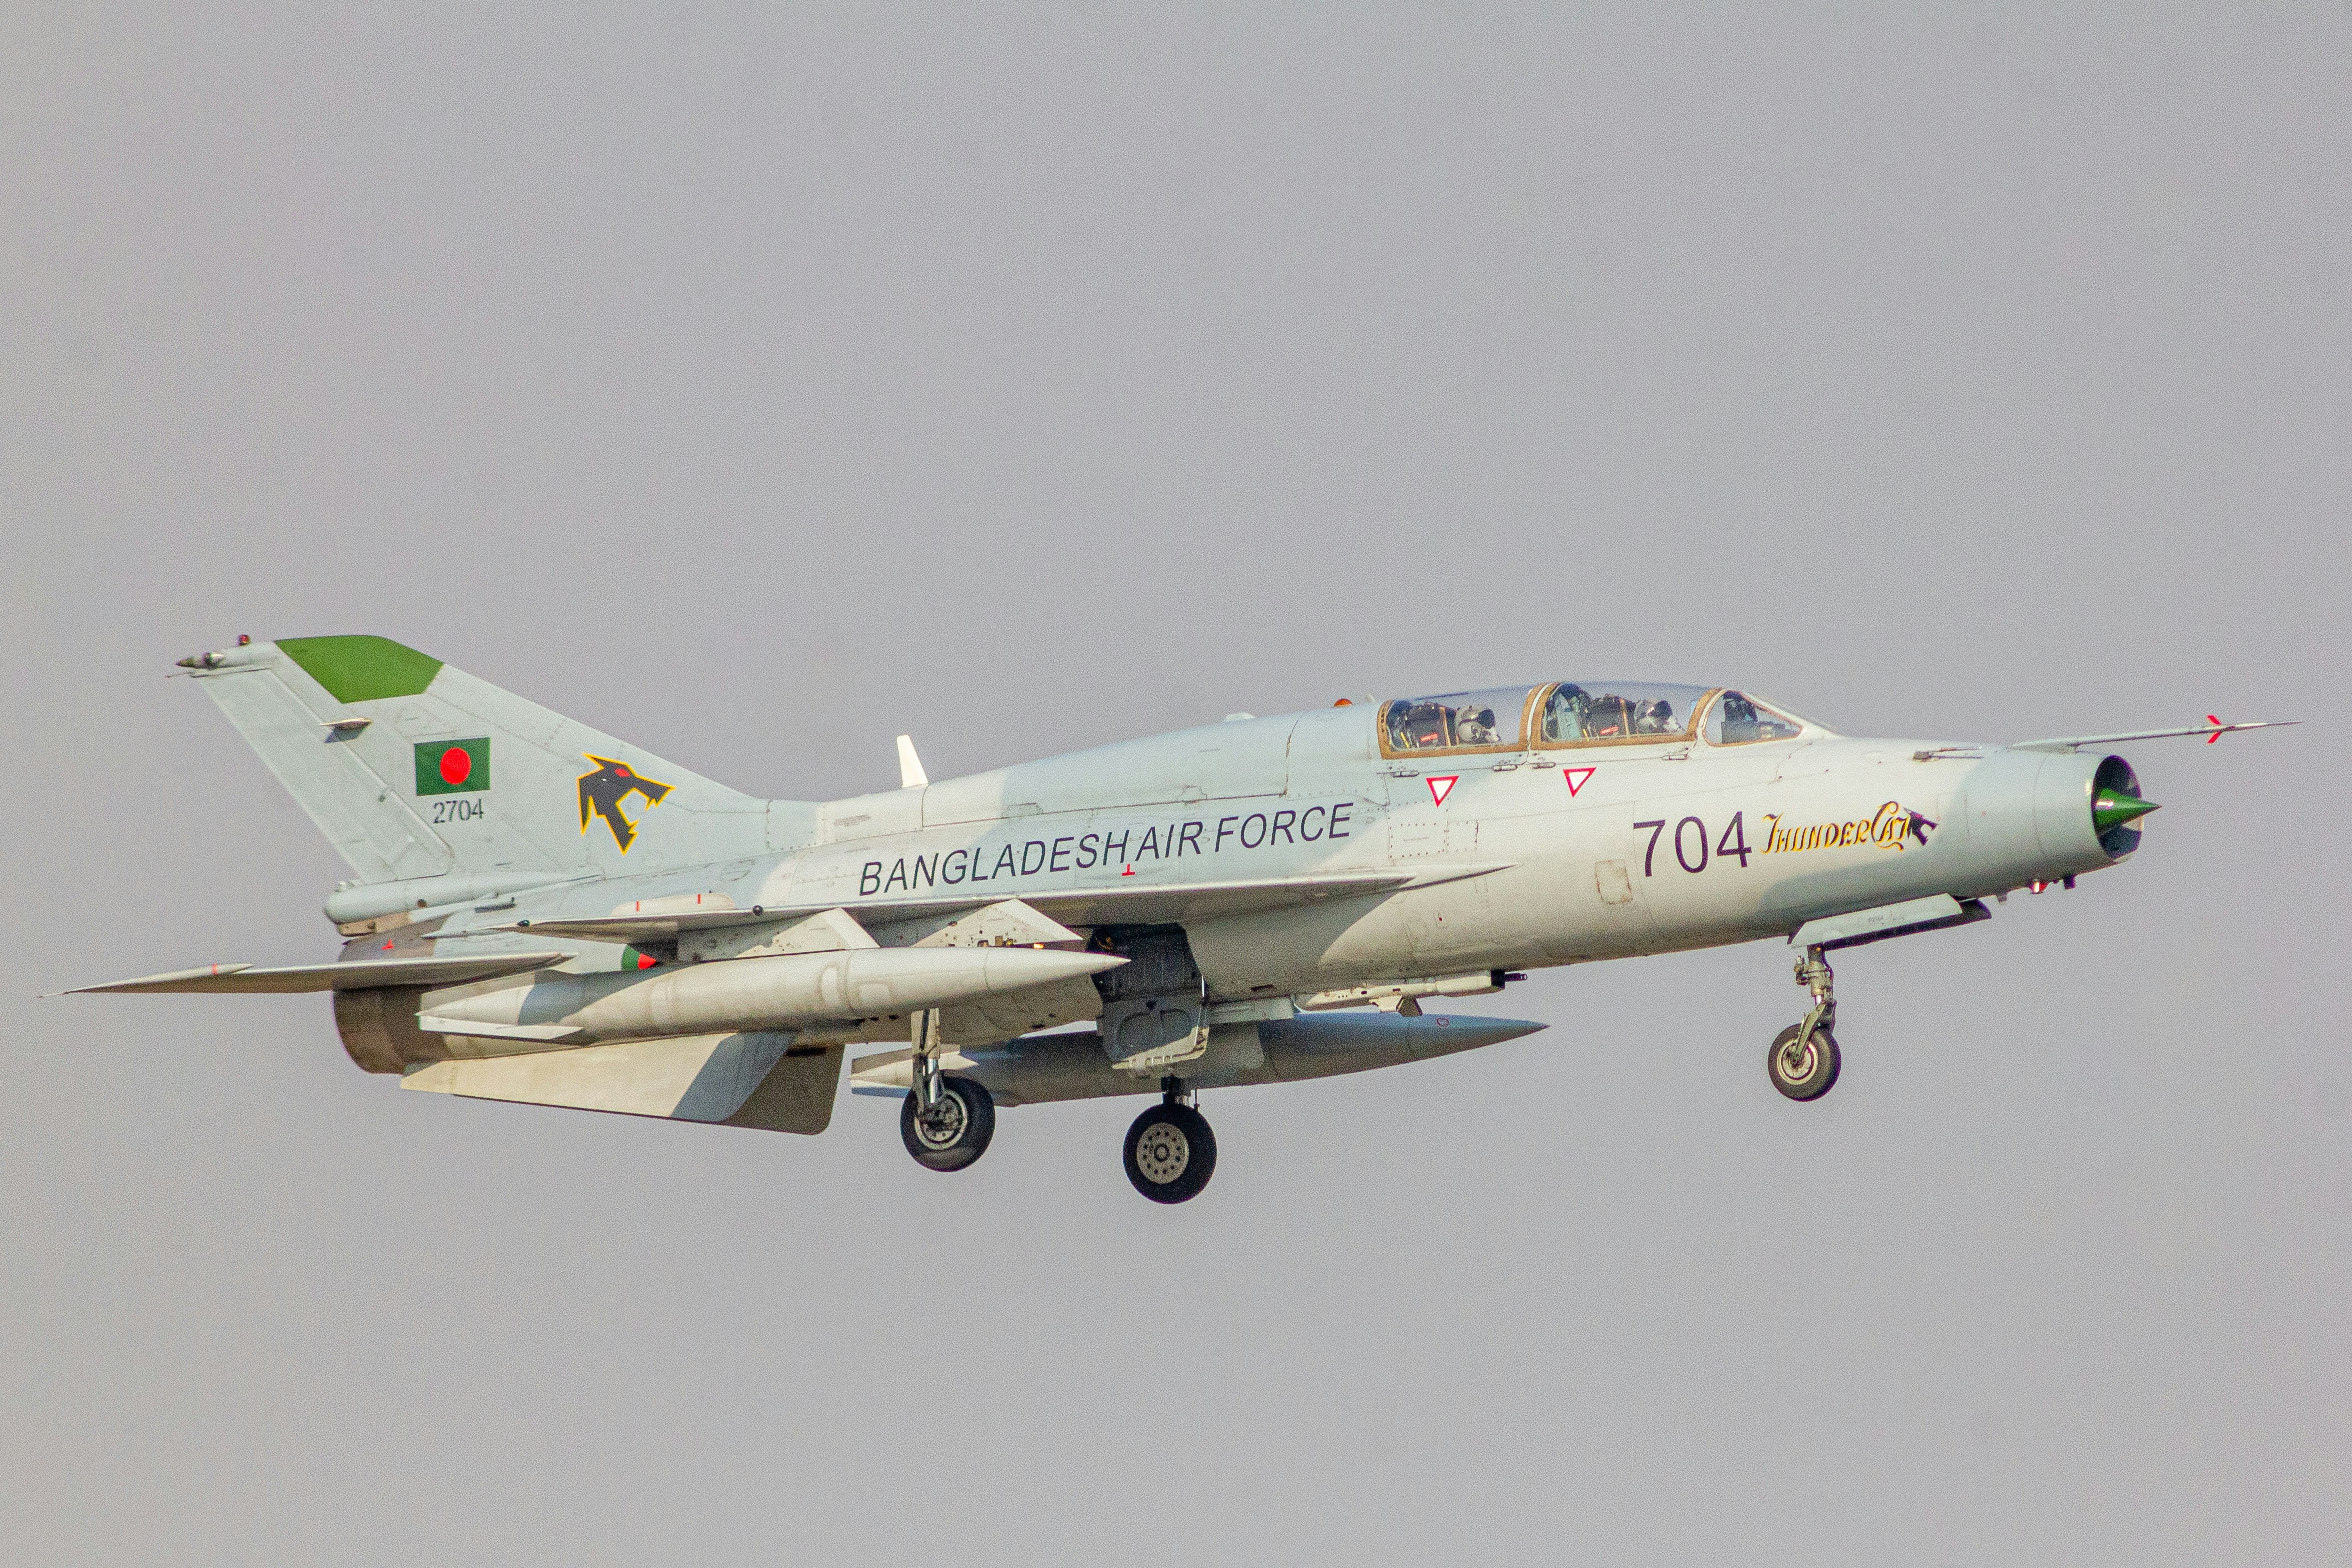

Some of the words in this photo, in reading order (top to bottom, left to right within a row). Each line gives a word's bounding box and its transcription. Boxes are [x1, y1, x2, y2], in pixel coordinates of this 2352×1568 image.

[432, 798, 484, 824] 2704
[1633, 811, 1752, 878] 704
[859, 829, 1129, 896] BANGLADESH
[1135, 821, 1204, 862] AIR
[1215, 802, 1354, 853] FORCE
